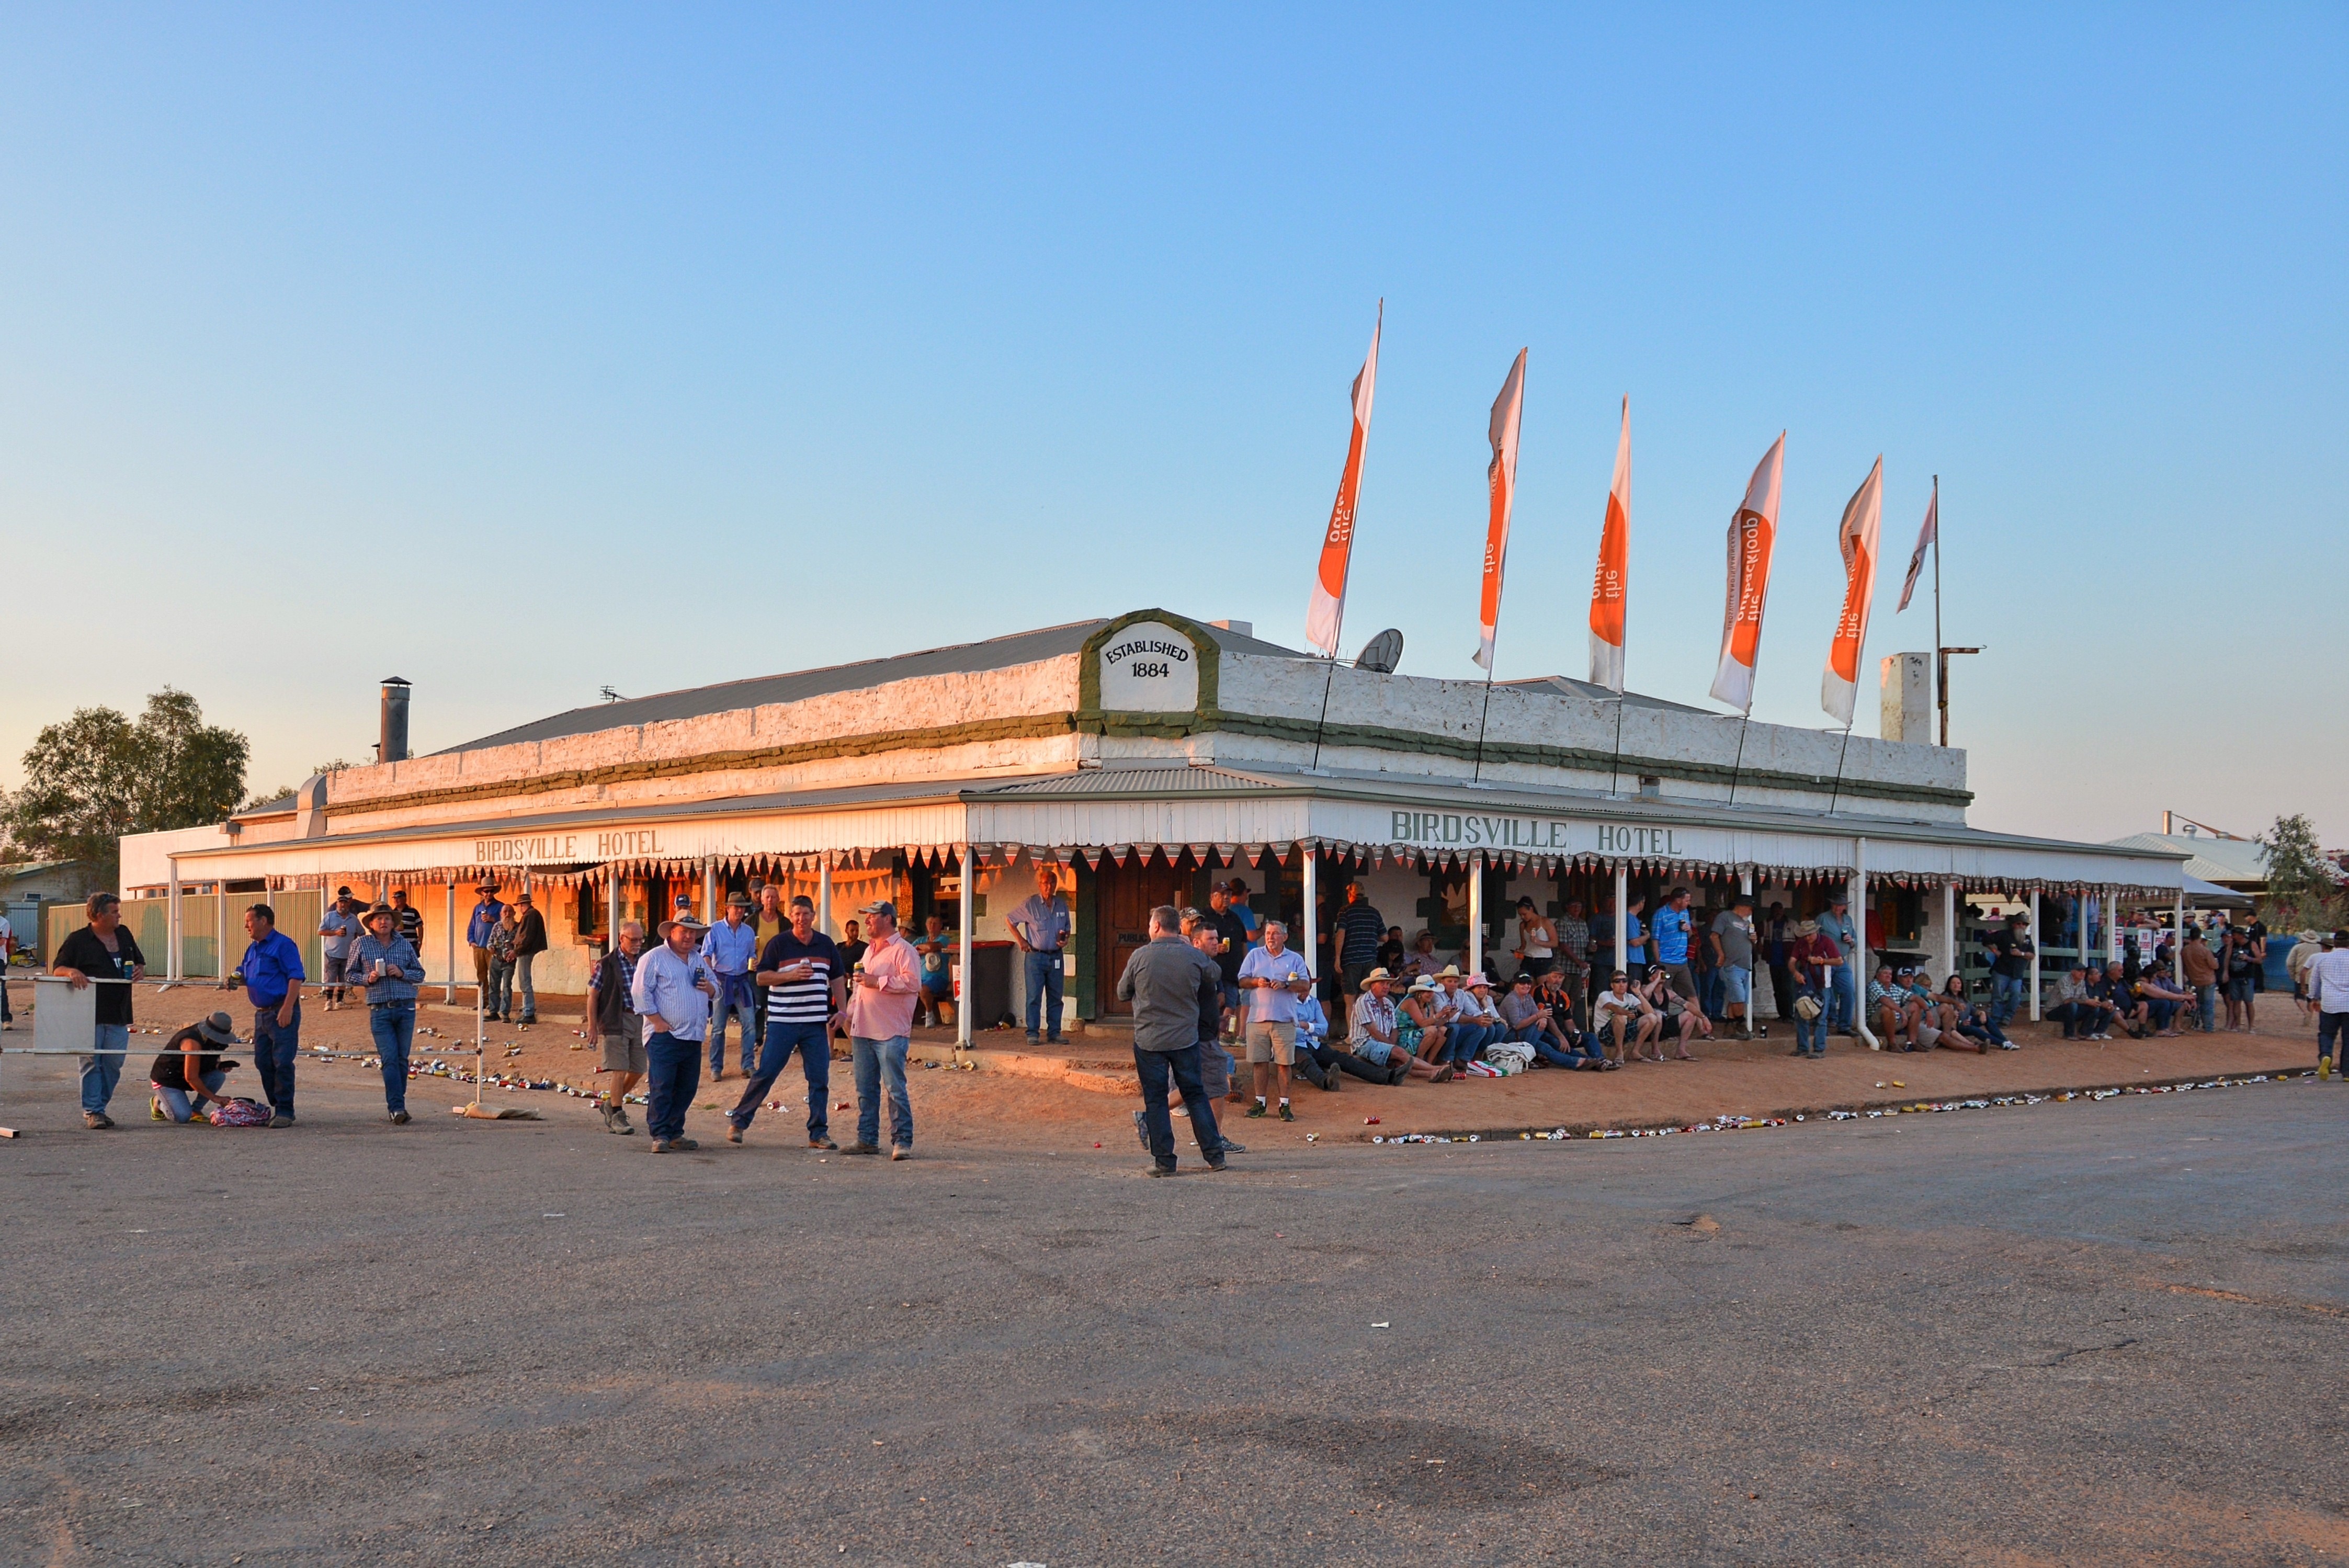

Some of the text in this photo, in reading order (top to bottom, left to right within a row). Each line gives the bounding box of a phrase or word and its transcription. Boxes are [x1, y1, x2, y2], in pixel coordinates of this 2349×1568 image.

[1106, 640, 1189, 665] ESTABLISHED
[1131, 662, 1170, 677] 1884
[1392, 811, 1682, 855] BIRDSVILLE HOTEL
[476, 831, 664, 862] BIRDSVILLE HOTEL
[1118, 933, 1148, 942] PUBLIC
